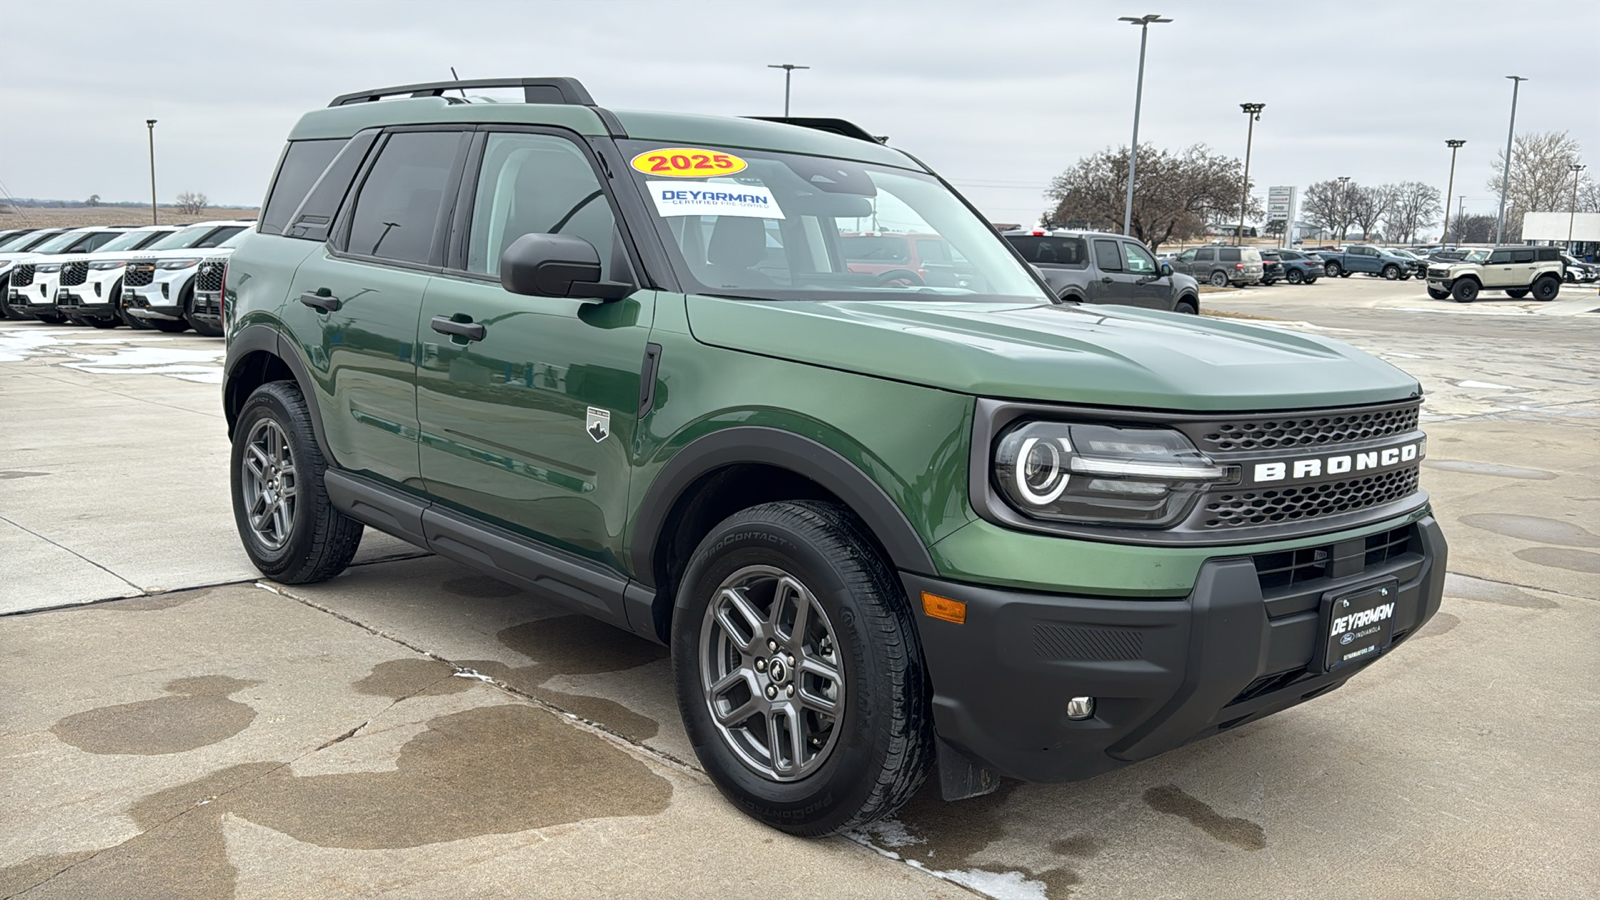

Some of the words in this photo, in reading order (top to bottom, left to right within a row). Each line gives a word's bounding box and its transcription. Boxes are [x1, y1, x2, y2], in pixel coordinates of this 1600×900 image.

[647, 154, 734, 172] 2025
[662, 190, 768, 204] DEYARMAN
[720, 201, 770, 209] PRE-OWNED
[1253, 443, 1417, 483] BRONCO
[1330, 602, 1395, 637] DEYARMAN
[1355, 625, 1381, 639] INDIANOLA
